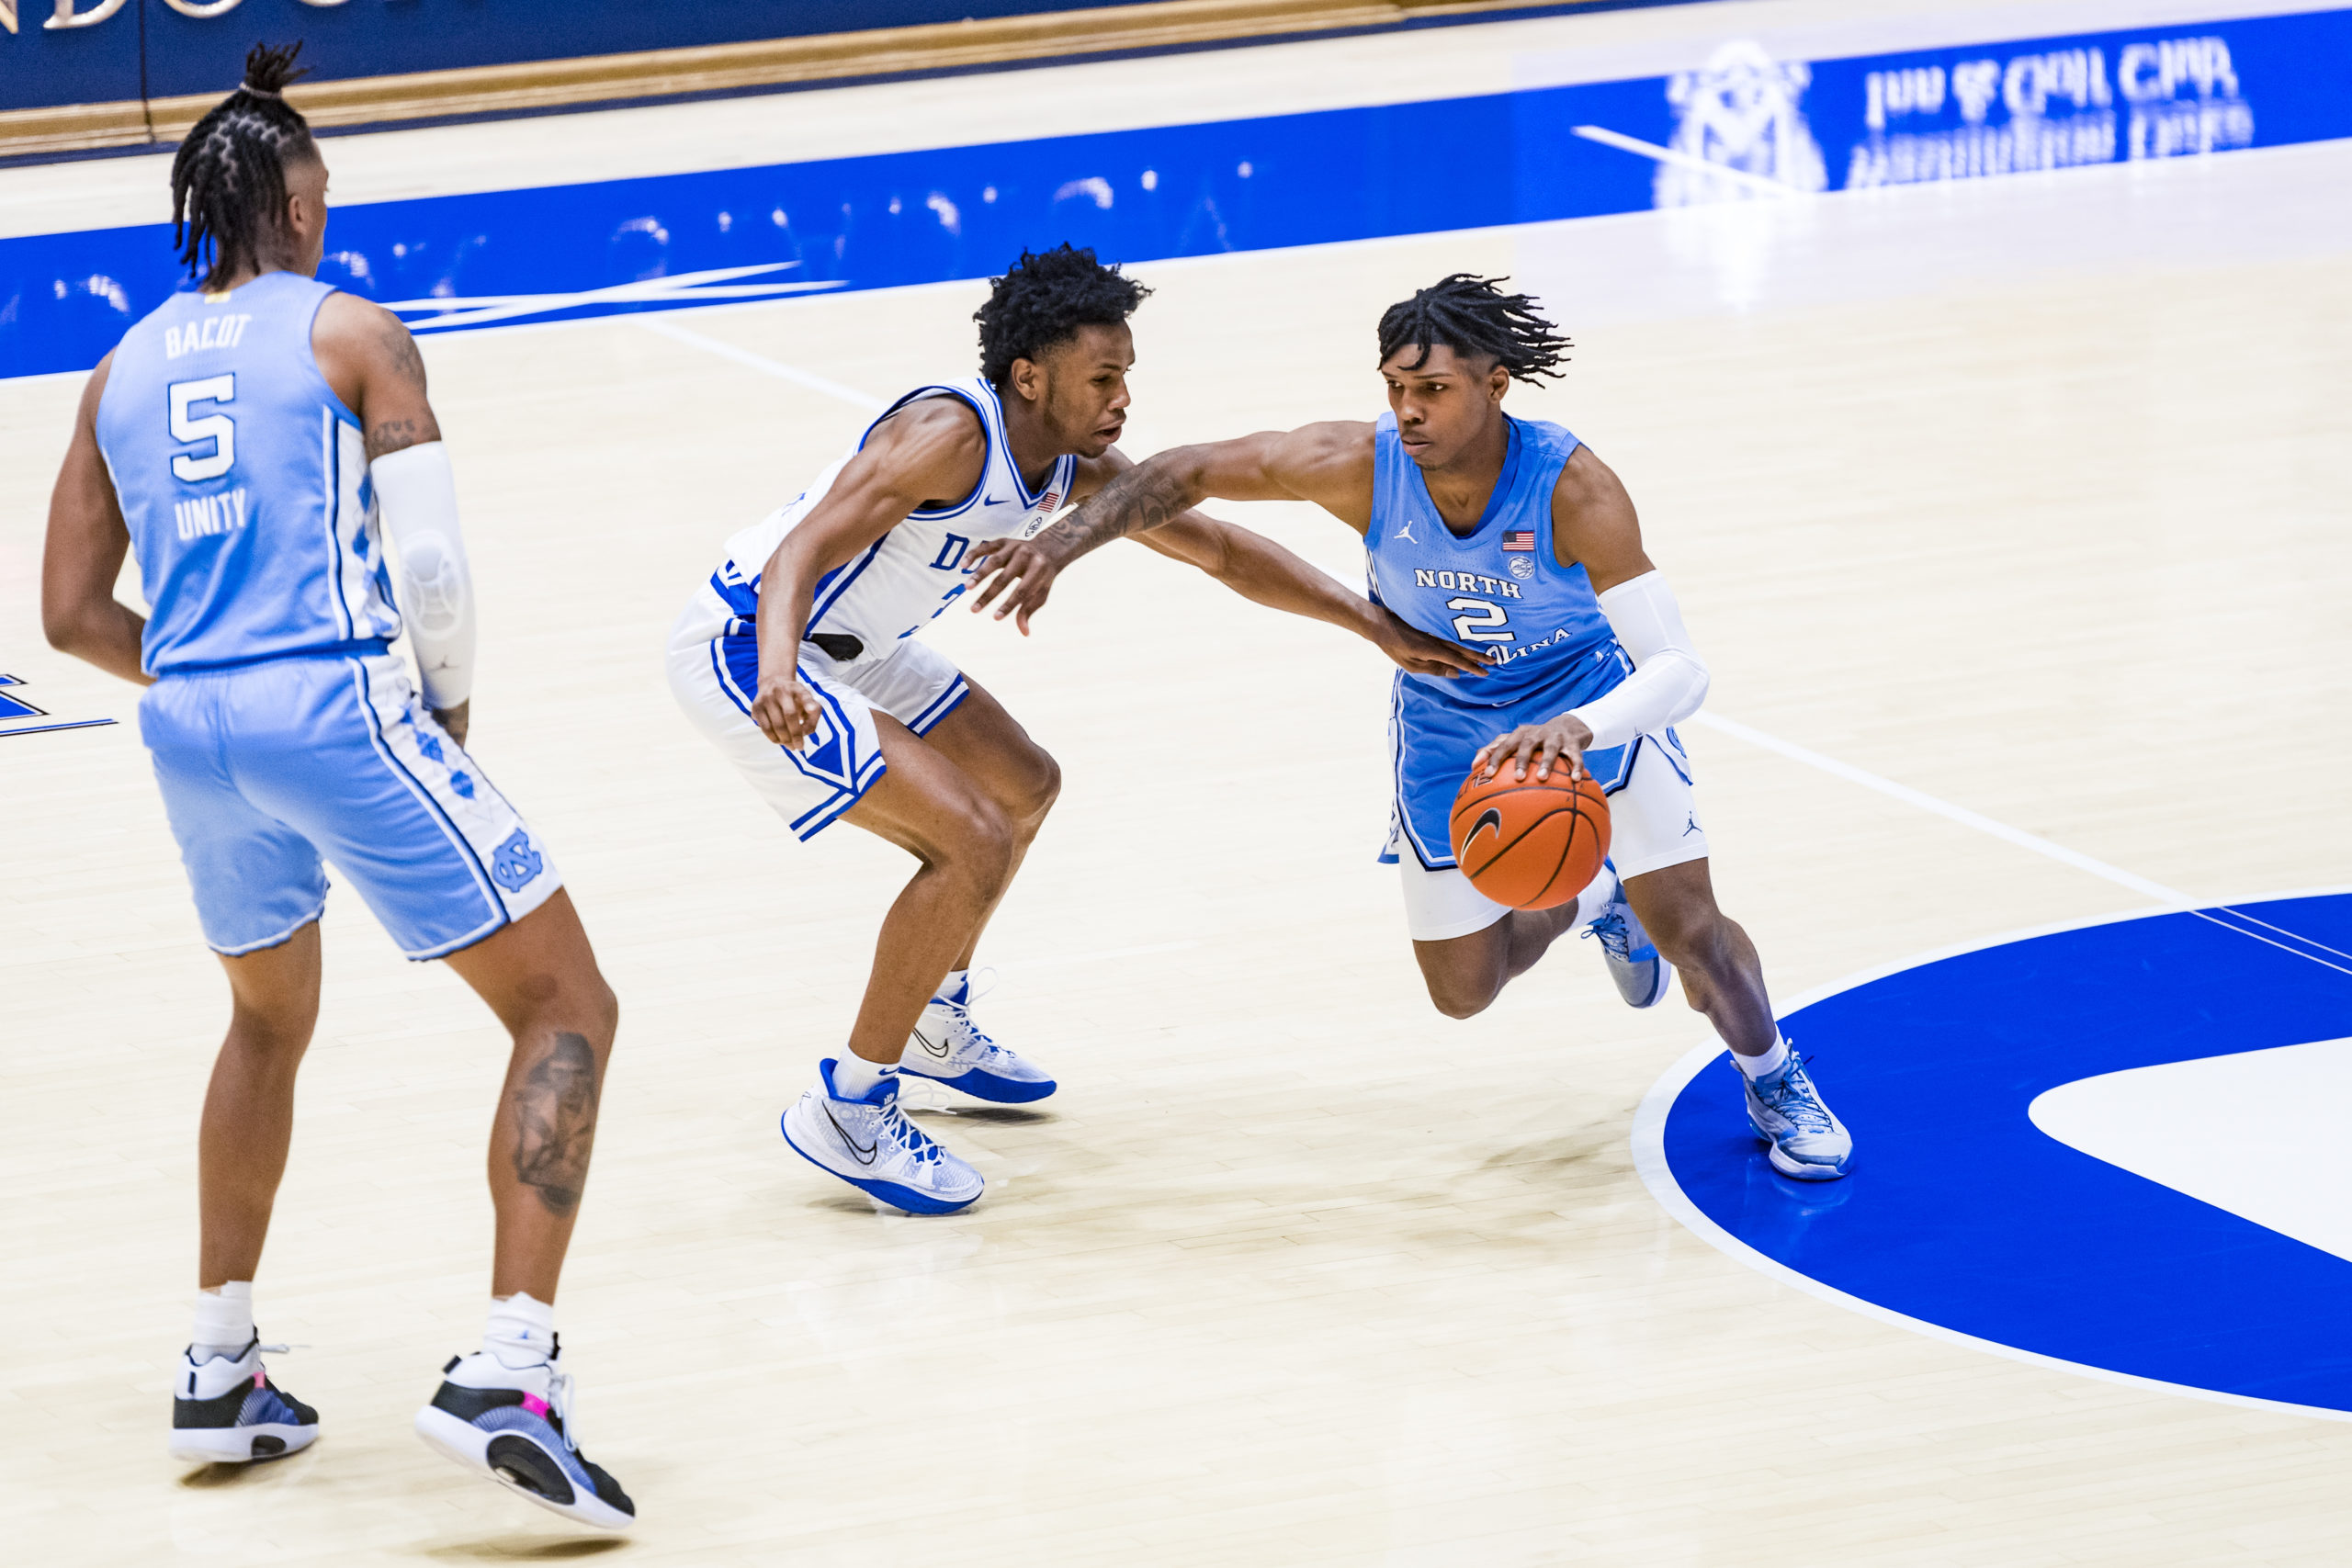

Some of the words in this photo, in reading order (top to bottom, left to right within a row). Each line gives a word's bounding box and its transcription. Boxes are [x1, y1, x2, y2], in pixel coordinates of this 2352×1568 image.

[164, 313, 253, 360] BACOT
[168, 371, 235, 483] 5
[174, 488, 246, 541] UNITY
[1414, 569, 1522, 599] NORTH
[1446, 597, 1516, 641] 2
